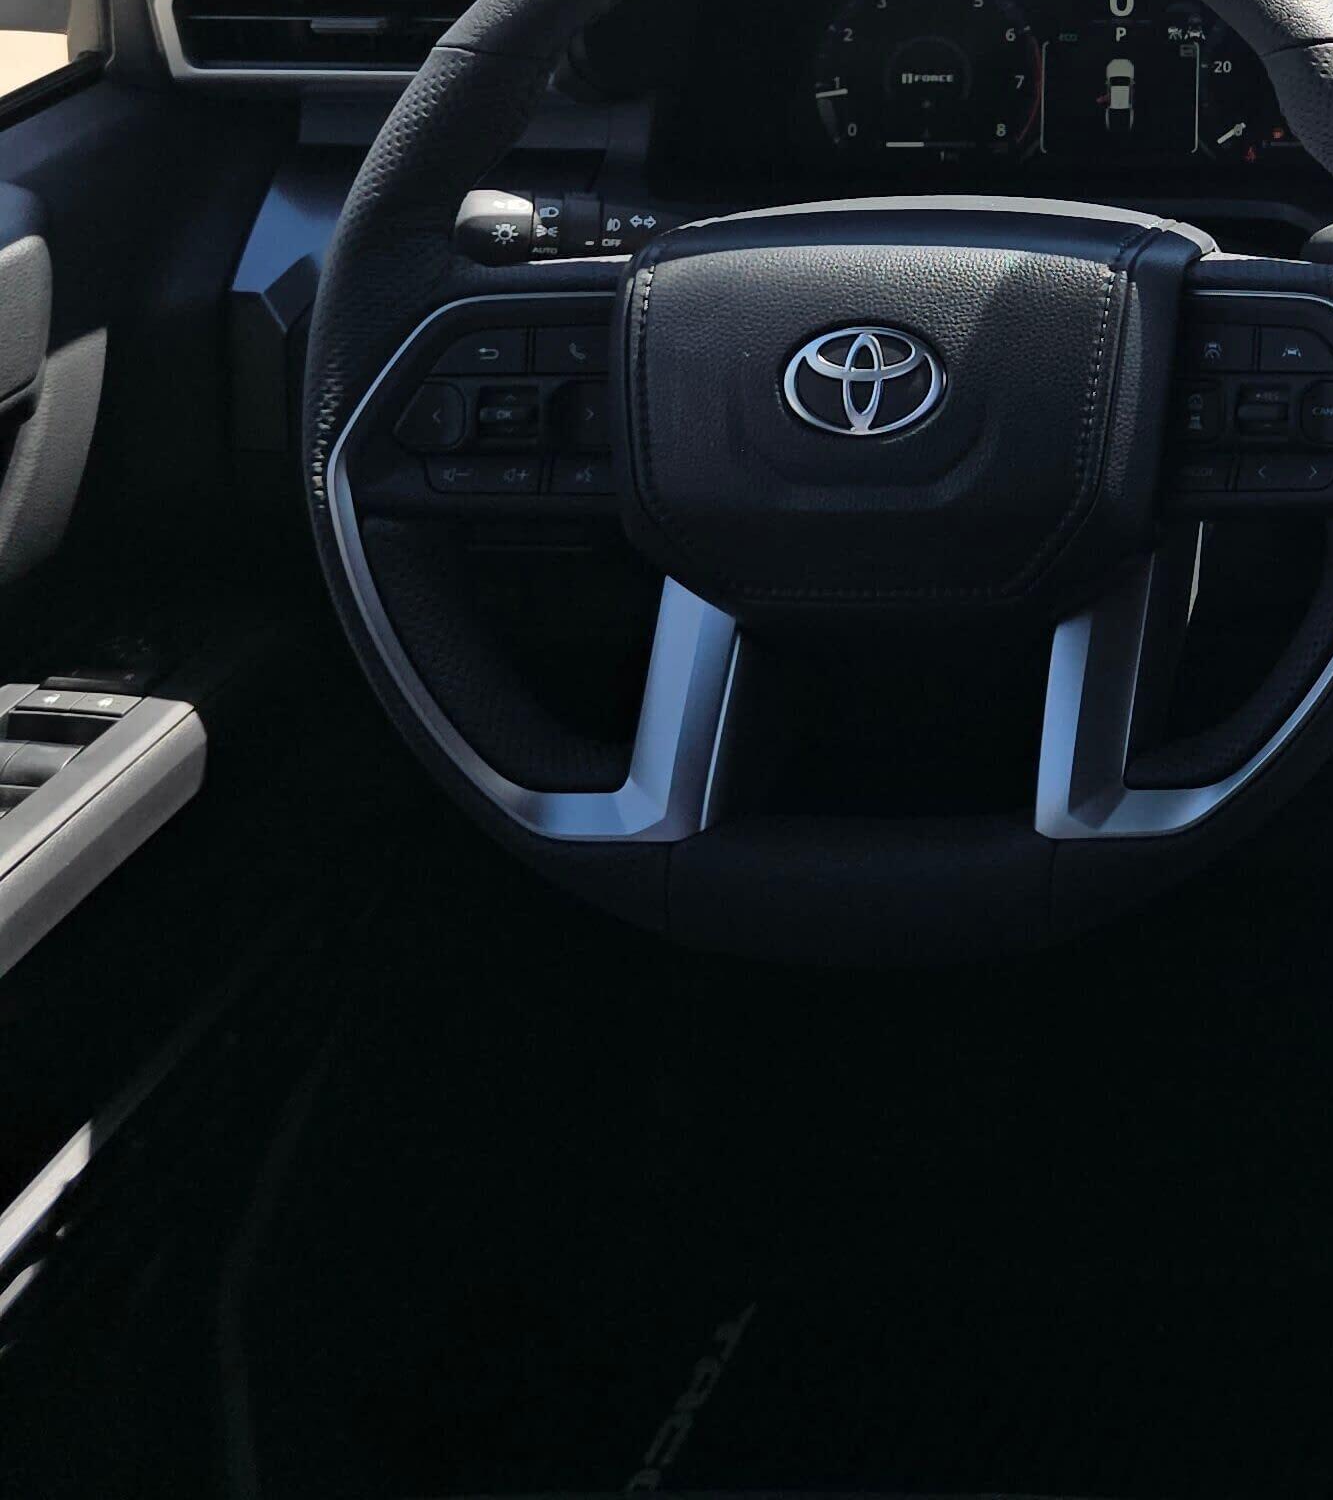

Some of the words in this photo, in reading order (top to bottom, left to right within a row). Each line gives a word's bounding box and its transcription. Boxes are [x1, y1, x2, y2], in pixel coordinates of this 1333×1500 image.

[843, 28, 853, 42] 2
[1005, 28, 1016, 42] 6
[1115, 27, 1128, 42] P
[1213, 60, 1233, 74] 20
[833, 76, 841, 89] 1
[1015, 75, 1025, 88] 7
[847, 124, 858, 137] 0
[996, 124, 1007, 137] 8
[601, 238, 622, 247] OFF
